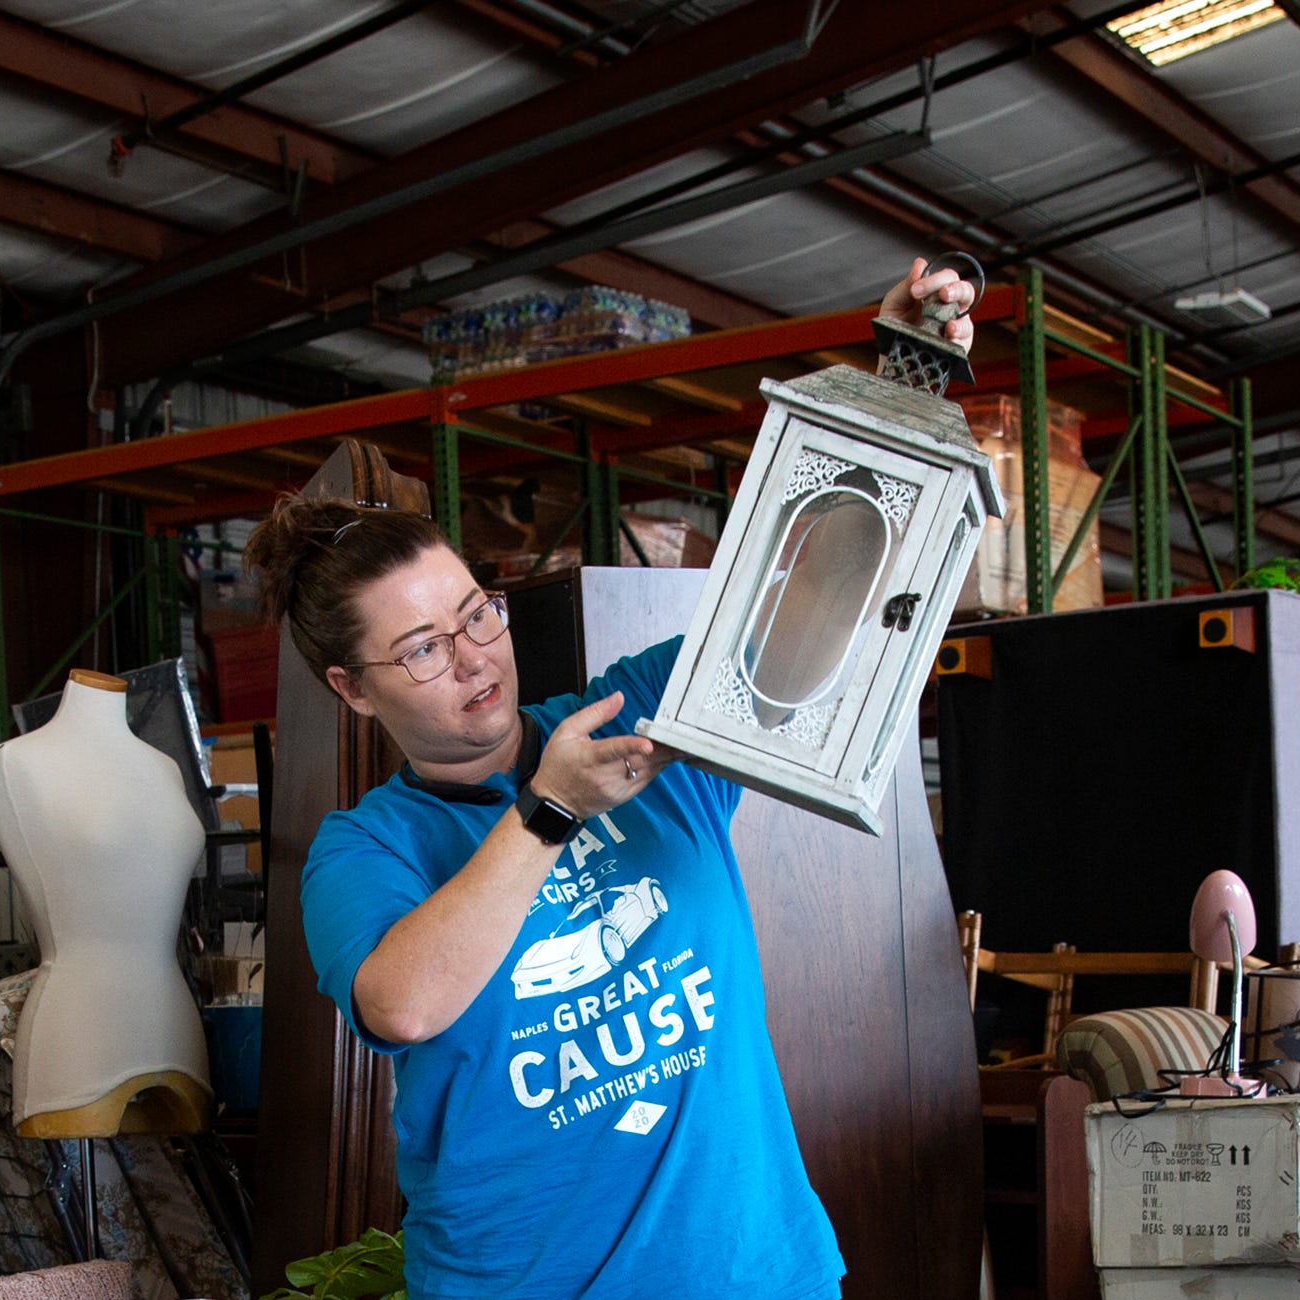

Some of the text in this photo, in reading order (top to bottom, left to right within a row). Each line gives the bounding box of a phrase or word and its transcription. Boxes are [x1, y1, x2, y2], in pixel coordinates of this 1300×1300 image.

[542, 872, 596, 905] CARS
[511, 947, 695, 1041] NAPLES GREAT FLORIDA
[509, 965, 716, 1109] CAUSE
[548, 1046, 707, 1130] ST. MATTHEW'S HOUSE
[1142, 1171, 1161, 1182] ITEM
[1179, 1171, 1212, 1183] MT-822
[1236, 1186, 1252, 1197] PCS
[1236, 1200, 1252, 1210] KGS
[1235, 1213, 1251, 1224] KGS
[1172, 1225, 1184, 1235] 98
[1195, 1225, 1207, 1236] 32
[1217, 1225, 1229, 1236] 23
[1238, 1227, 1251, 1237] CM
